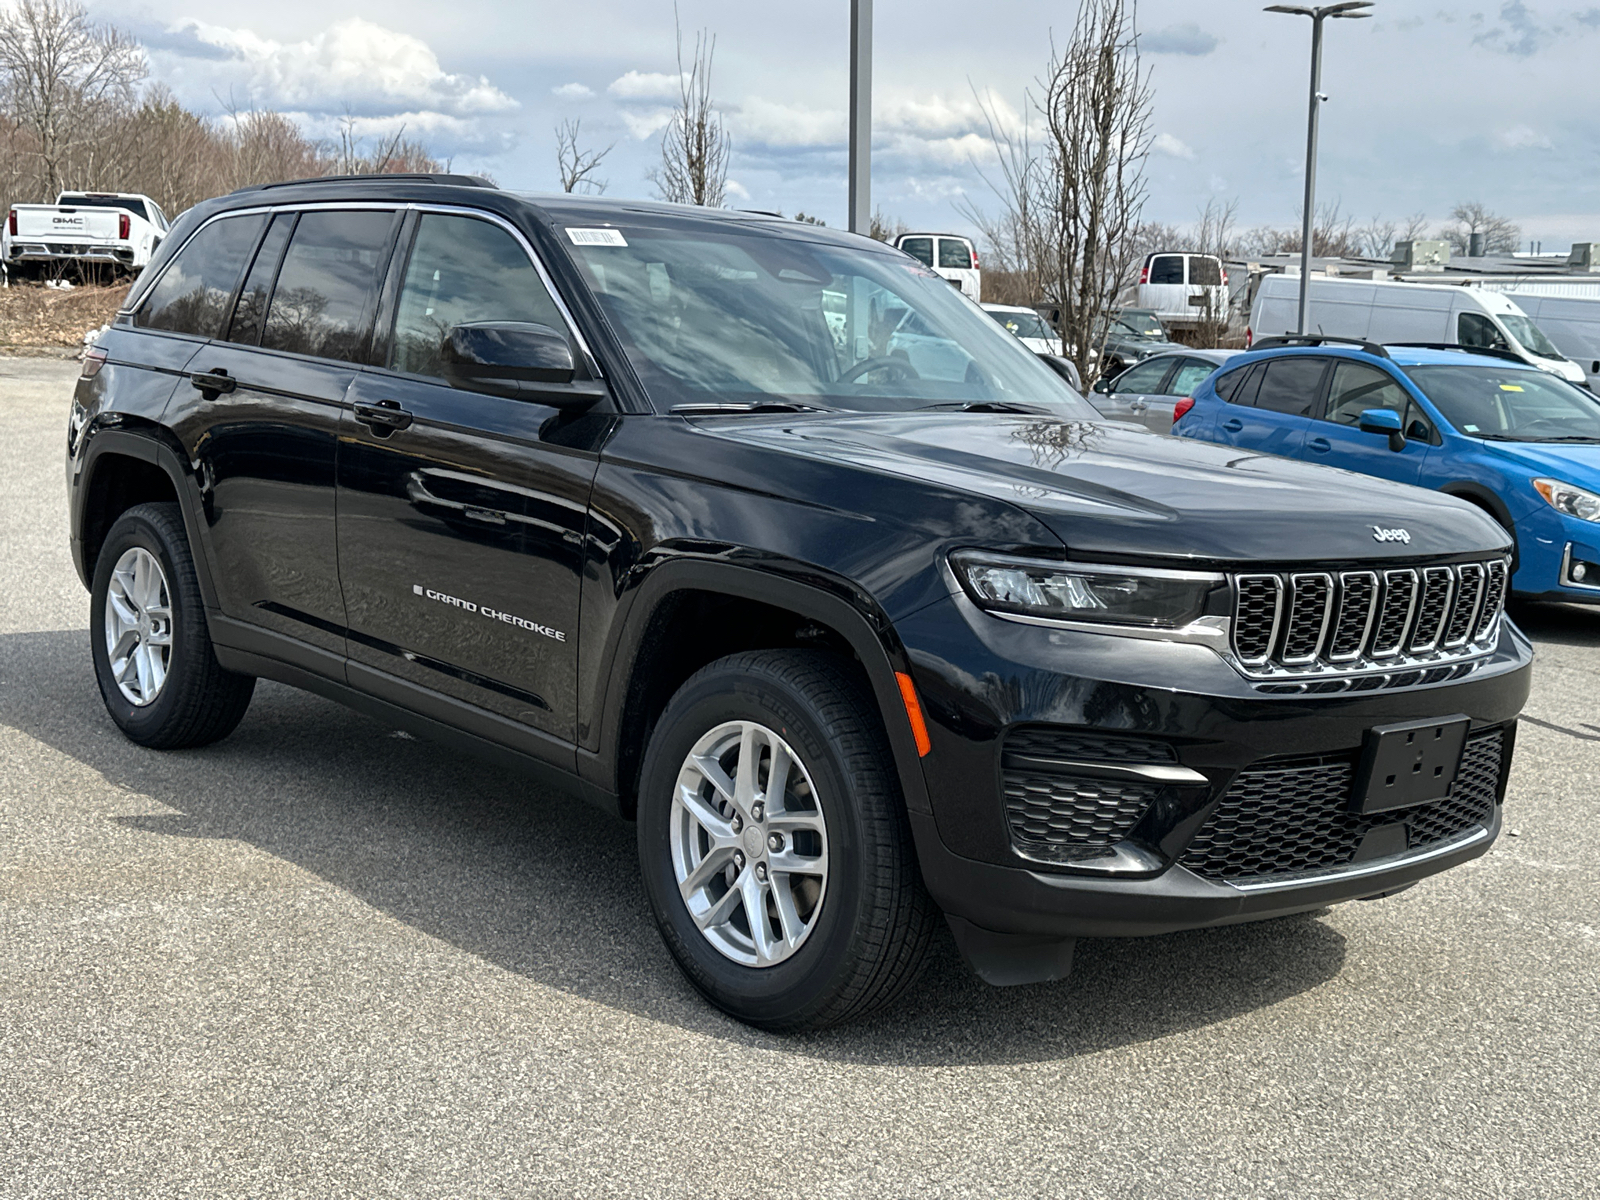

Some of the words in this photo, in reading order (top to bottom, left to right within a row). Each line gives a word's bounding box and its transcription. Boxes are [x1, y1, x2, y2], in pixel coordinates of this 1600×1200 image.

[1373, 525, 1411, 544] Jeep
[426, 588, 478, 613] GRAND
[481, 606, 566, 642] CHEROKEE
